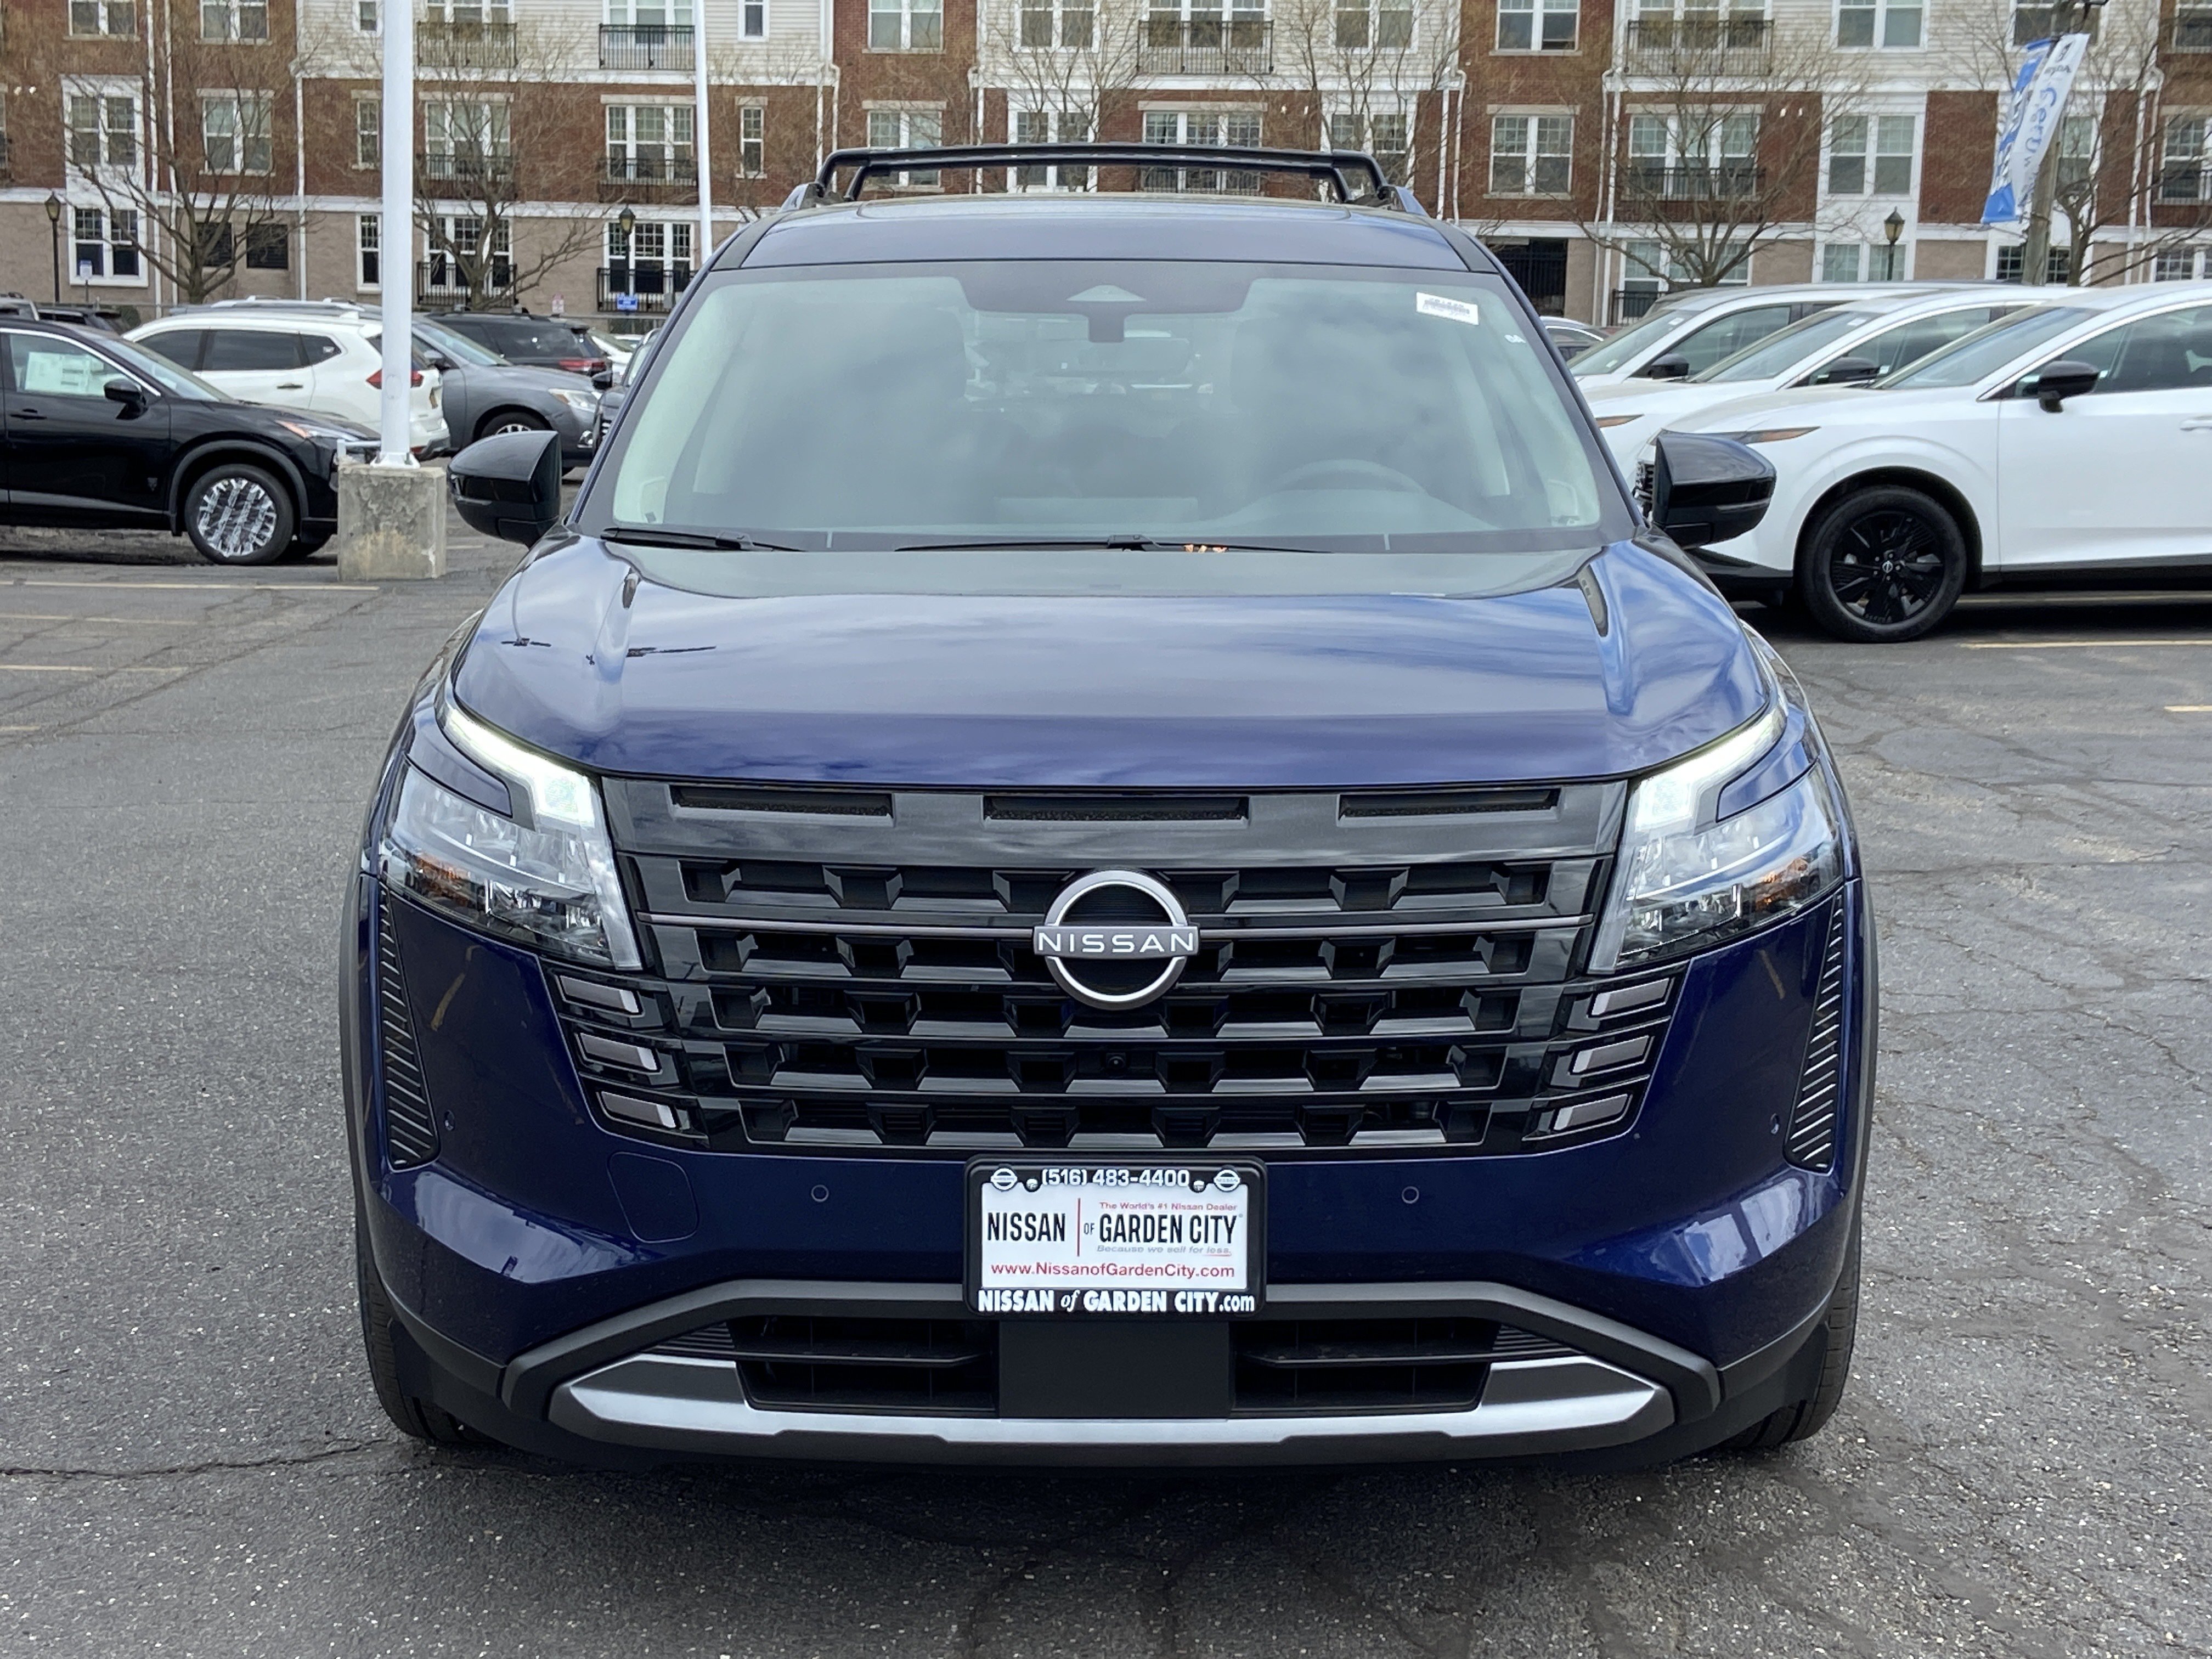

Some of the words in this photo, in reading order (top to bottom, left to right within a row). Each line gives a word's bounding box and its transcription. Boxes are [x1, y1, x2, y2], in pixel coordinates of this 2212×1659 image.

[1038, 932, 1193, 953] NISSAN
[1042, 1168, 1088, 1186] (516)
[1092, 1168, 1190, 1187] 483-4400
[1120, 1202, 1155, 1210] World's
[1206, 1203, 1238, 1211] Dealer
[988, 1212, 1066, 1242] NISSAN
[1084, 1222, 1095, 1235] OF
[1099, 1214, 1183, 1243] GARDEN
[1189, 1214, 1237, 1244] CITY
[1097, 1245, 1144, 1253] Because
[1189, 1246, 1204, 1254] for
[991, 1261, 1234, 1279] www.NissanofGardenCity.com
[978, 1289, 1054, 1312] NISSAN
[1060, 1289, 1081, 1312] of
[1083, 1290, 1167, 1312] GARDEN
[1174, 1290, 1255, 1313] CITY.com
